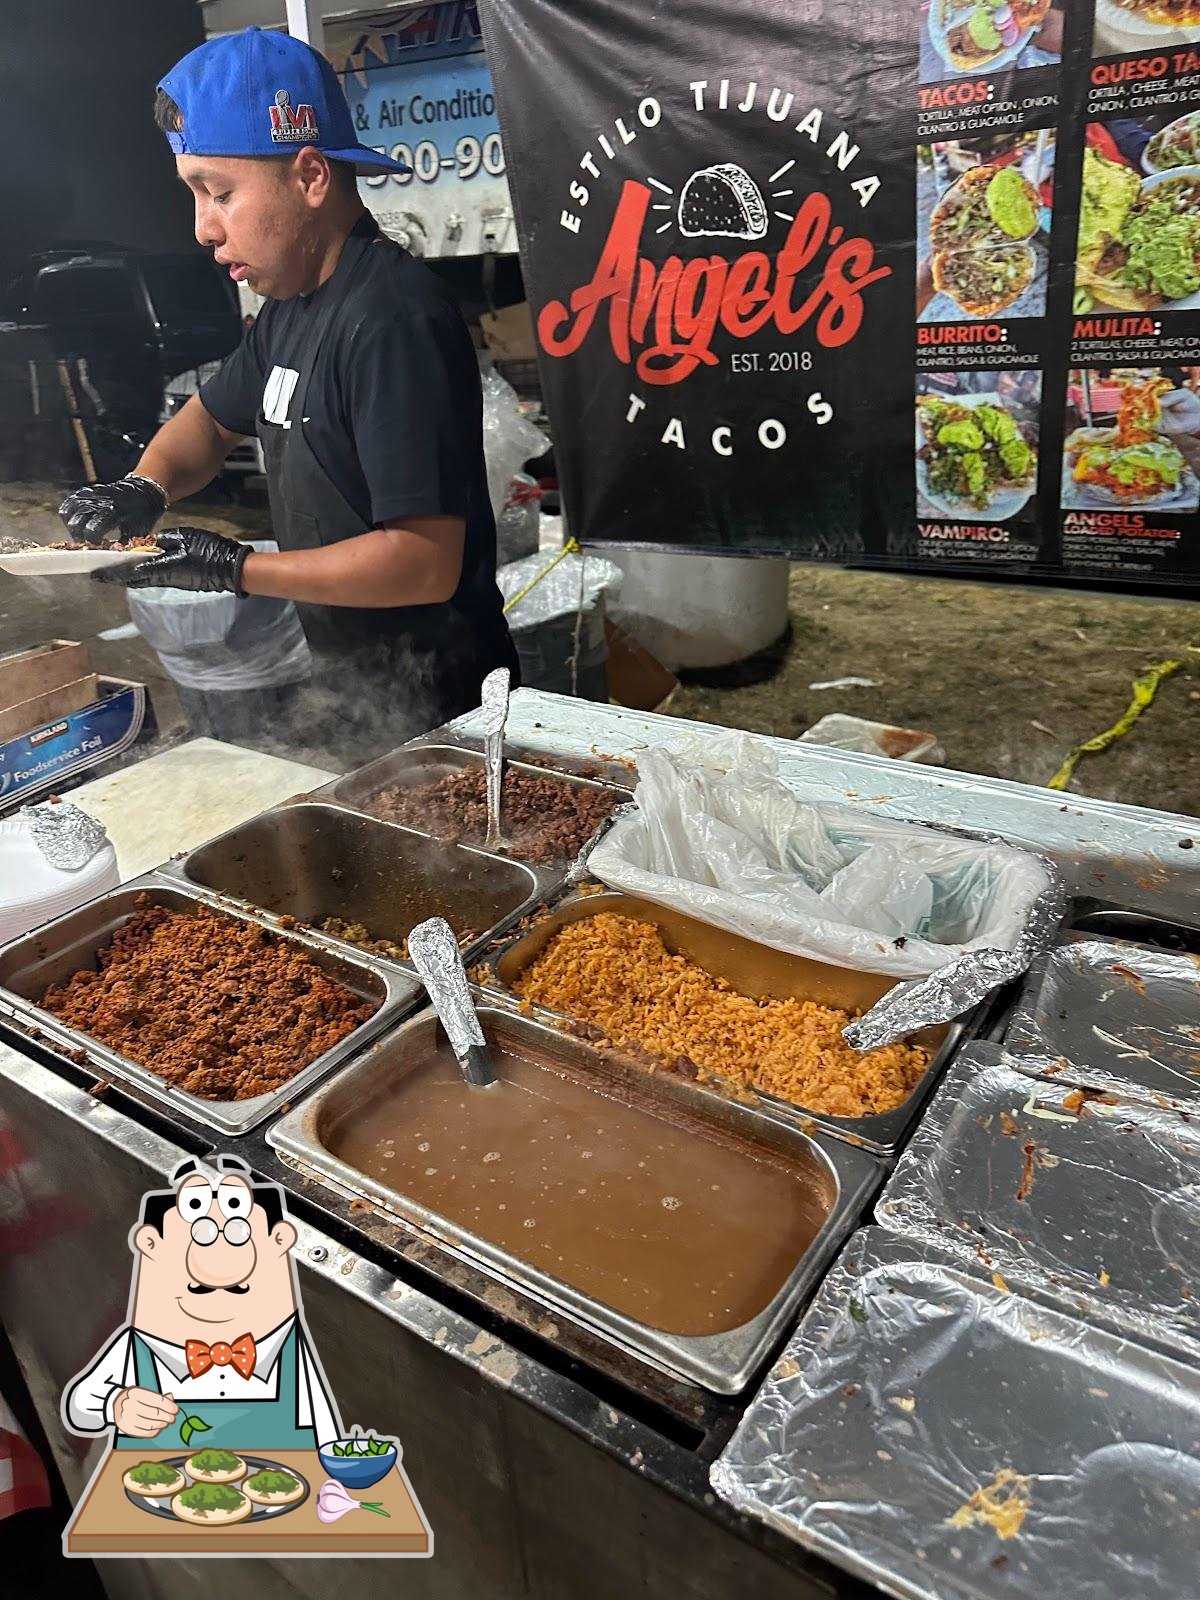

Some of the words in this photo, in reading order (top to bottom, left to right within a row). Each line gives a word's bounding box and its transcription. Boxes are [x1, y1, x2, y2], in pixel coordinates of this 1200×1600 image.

[1090, 56, 1169, 86] QUESO
[917, 80, 995, 109] TACOS:
[1179, 90, 1188, 102] &
[356, 103, 370, 131] &
[379, 98, 405, 128] Air
[409, 87, 495, 124] Conditio
[959, 119, 967, 131] &
[968, 112, 1025, 129] GUACAMOLE
[560, 97, 661, 233] ESTILO
[690, 79, 881, 207] TIJUANA
[537, 179, 892, 386] Angel's
[917, 324, 1008, 345] BURRITO:
[1072, 317, 1162, 338] MULITA:
[731, 354, 764, 372] EST.
[769, 351, 813, 372] 2018
[624, 391, 834, 456] TACOS
[1063, 512, 1145, 528] ANGELS
[1063, 525, 1116, 536] LOADED
[917, 524, 1010, 542] VAMPIRO:
[13, 747, 81, 783] Foodservice
[81, 735, 103, 752] Foil
